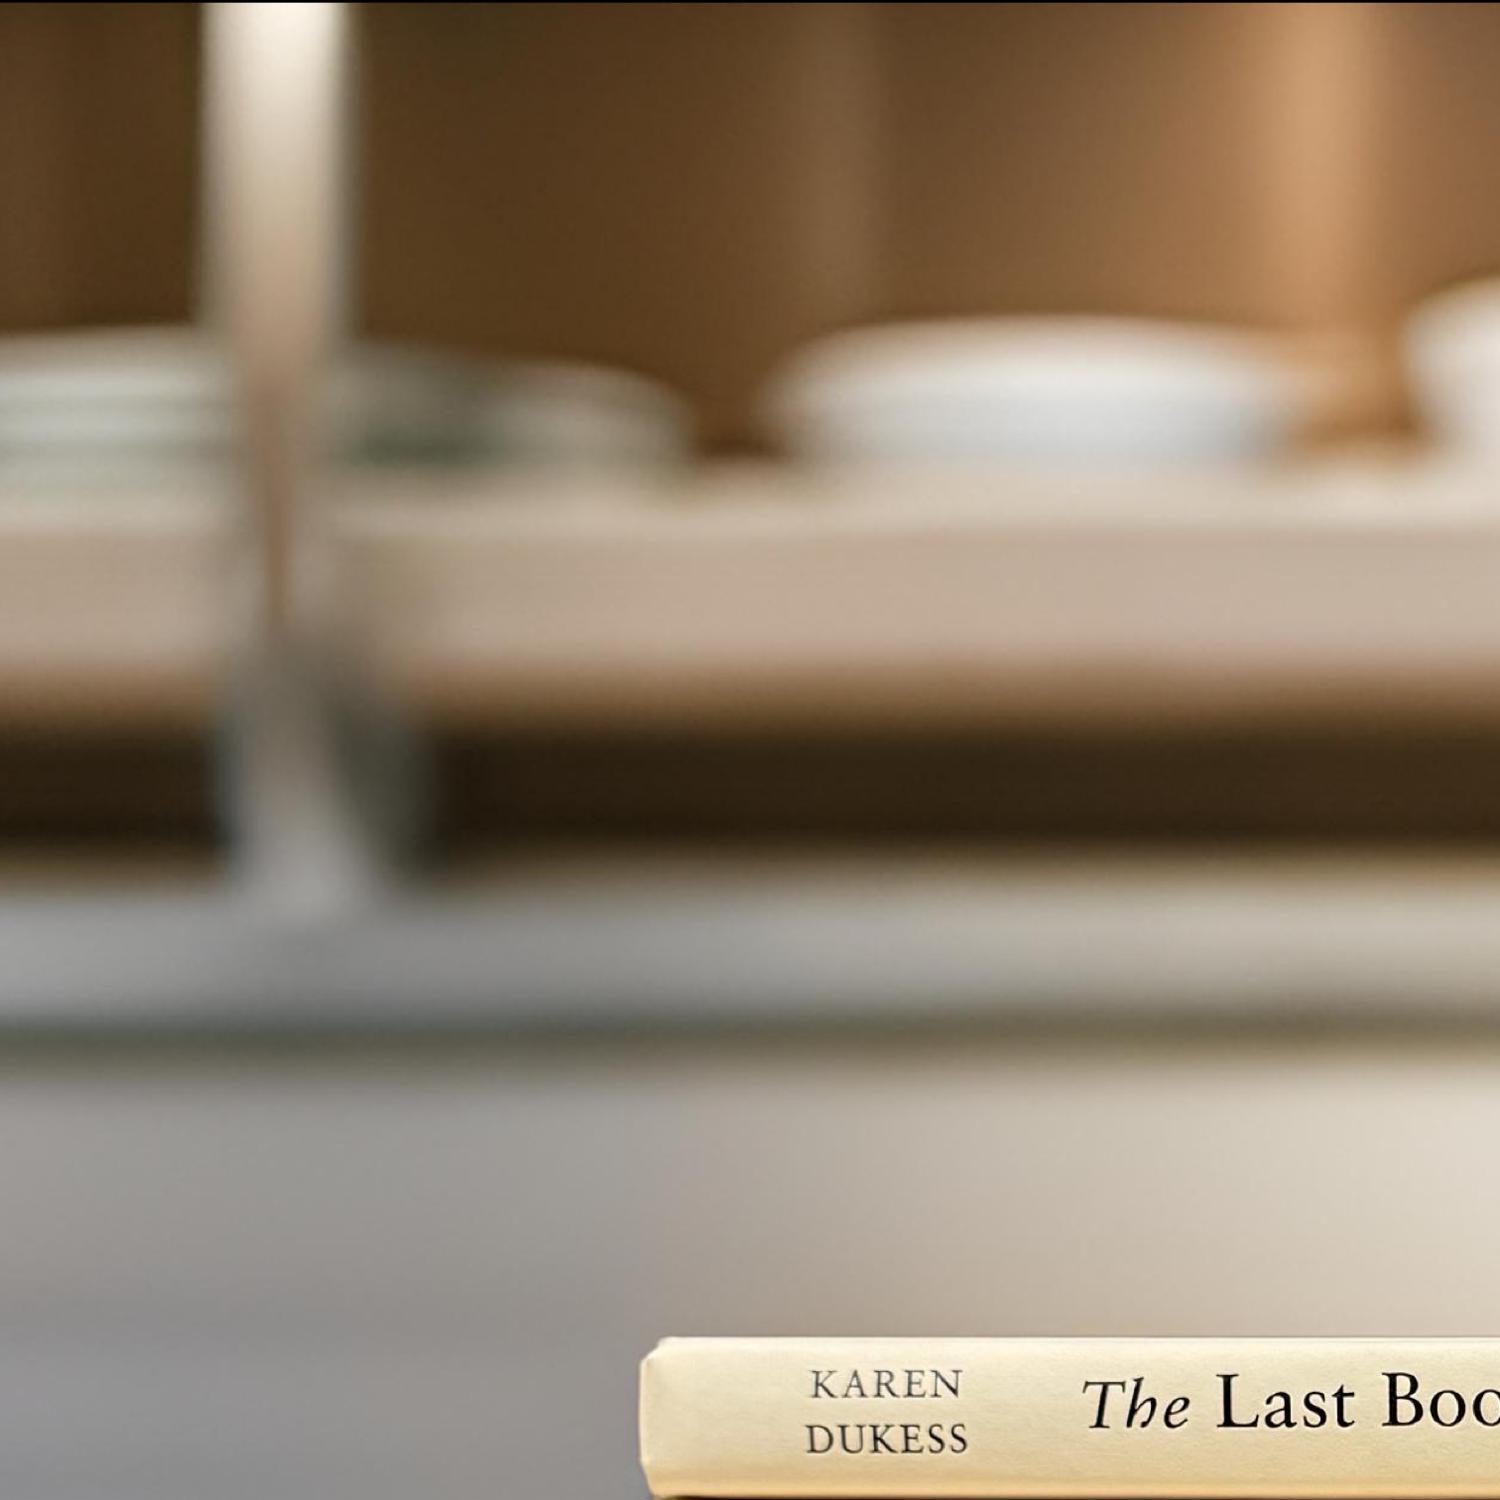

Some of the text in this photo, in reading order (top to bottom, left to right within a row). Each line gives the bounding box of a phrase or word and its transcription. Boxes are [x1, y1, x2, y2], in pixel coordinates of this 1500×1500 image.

[811, 1369, 963, 1399] KAREN
[1082, 1376, 1191, 1430] The
[1215, 1373, 1356, 1429] Last
[804, 1422, 969, 1455] DUKESS
